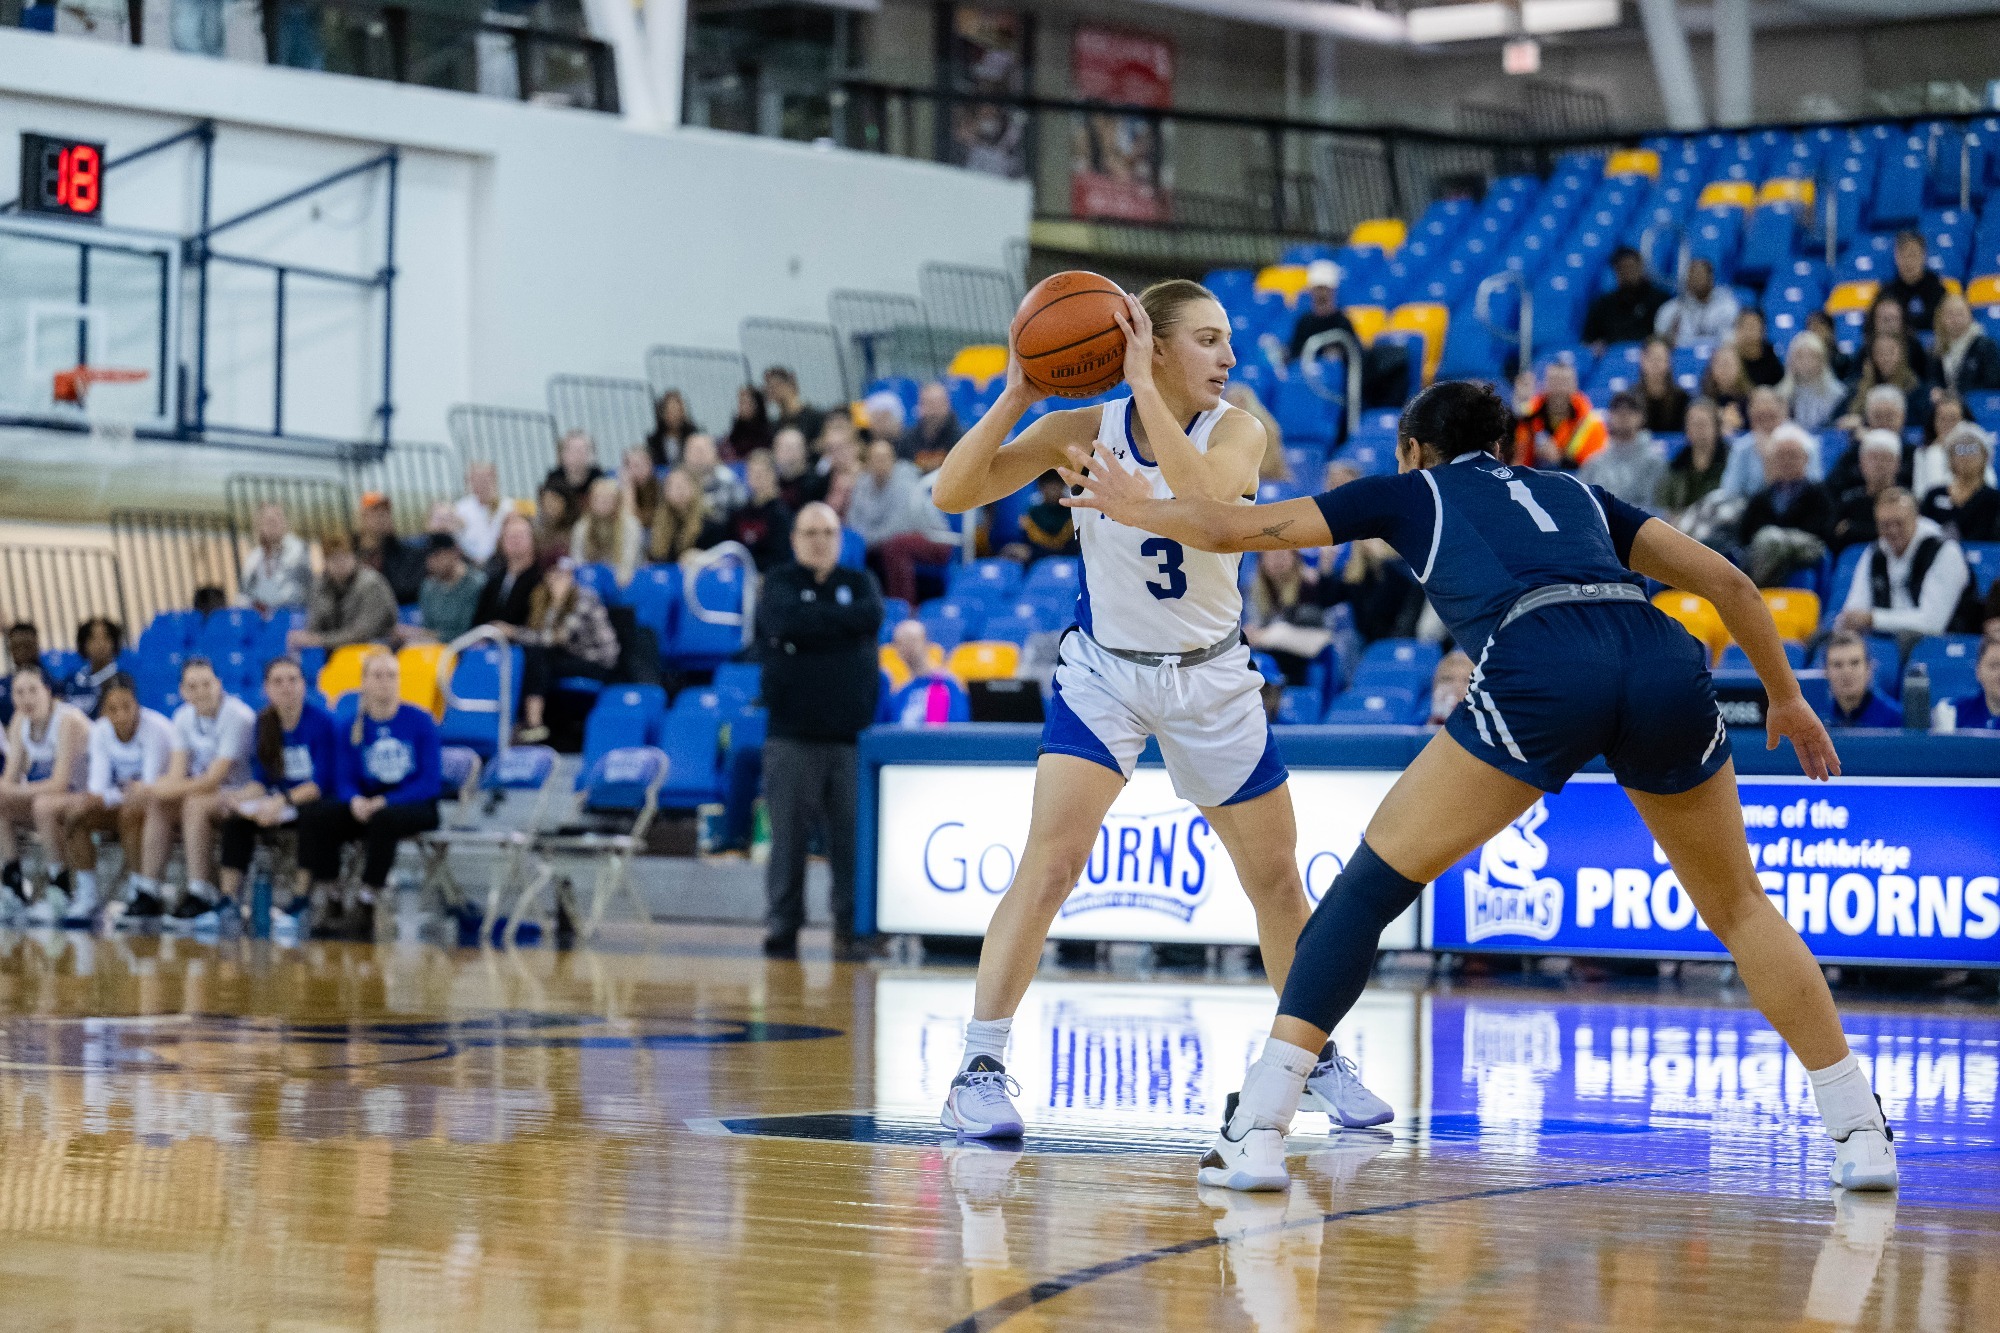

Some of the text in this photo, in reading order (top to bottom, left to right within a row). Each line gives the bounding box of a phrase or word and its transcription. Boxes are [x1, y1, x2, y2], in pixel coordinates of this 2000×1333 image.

[57, 145, 99, 212] 18
[1505, 479, 1560, 532] 1
[1140, 537, 1188, 600] 3
[1739, 798, 1849, 829] me of the
[924, 821, 1016, 894] Go
[1074, 815, 1210, 896] ORNS
[1763, 837, 1790, 867] of
[1791, 838, 1911, 875] Lethbridge
[1575, 866, 2000, 940] PROGHORNS
